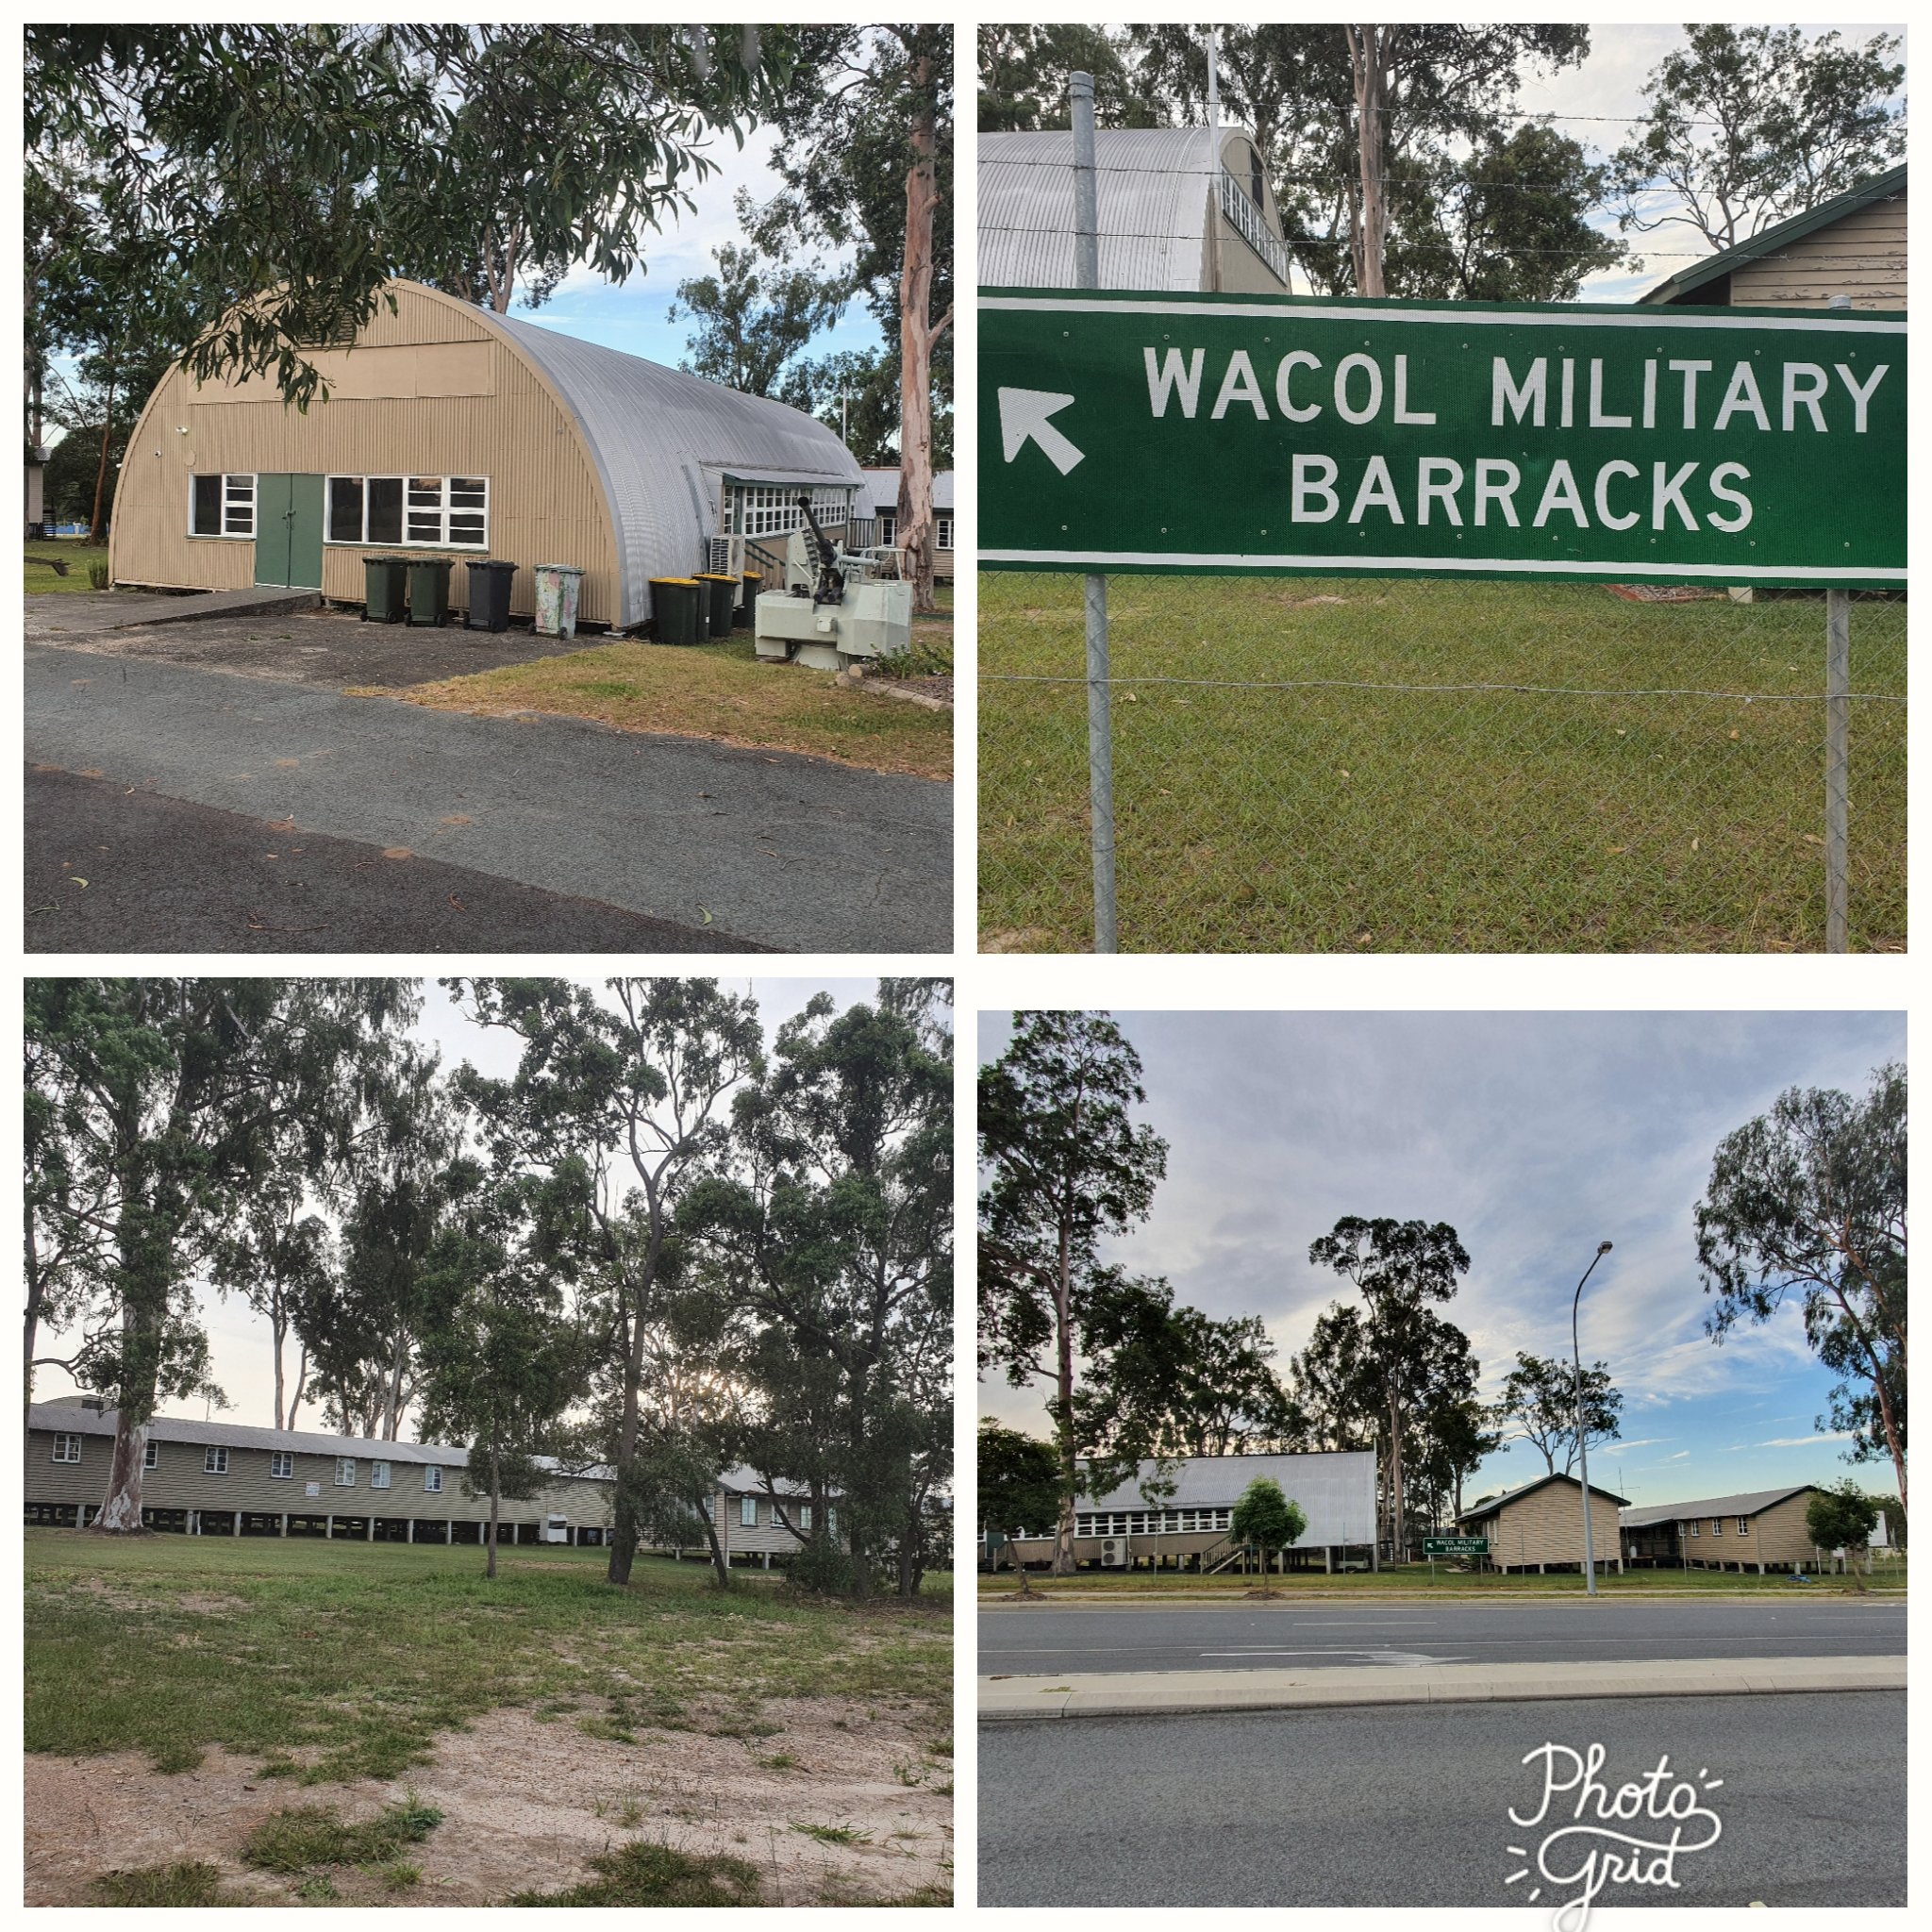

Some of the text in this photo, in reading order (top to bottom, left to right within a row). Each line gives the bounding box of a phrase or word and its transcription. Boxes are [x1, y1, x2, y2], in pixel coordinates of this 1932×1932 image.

[1143, 346, 1890, 433] WACOL MILITARY
[1291, 454, 1754, 533] BARRACKS
